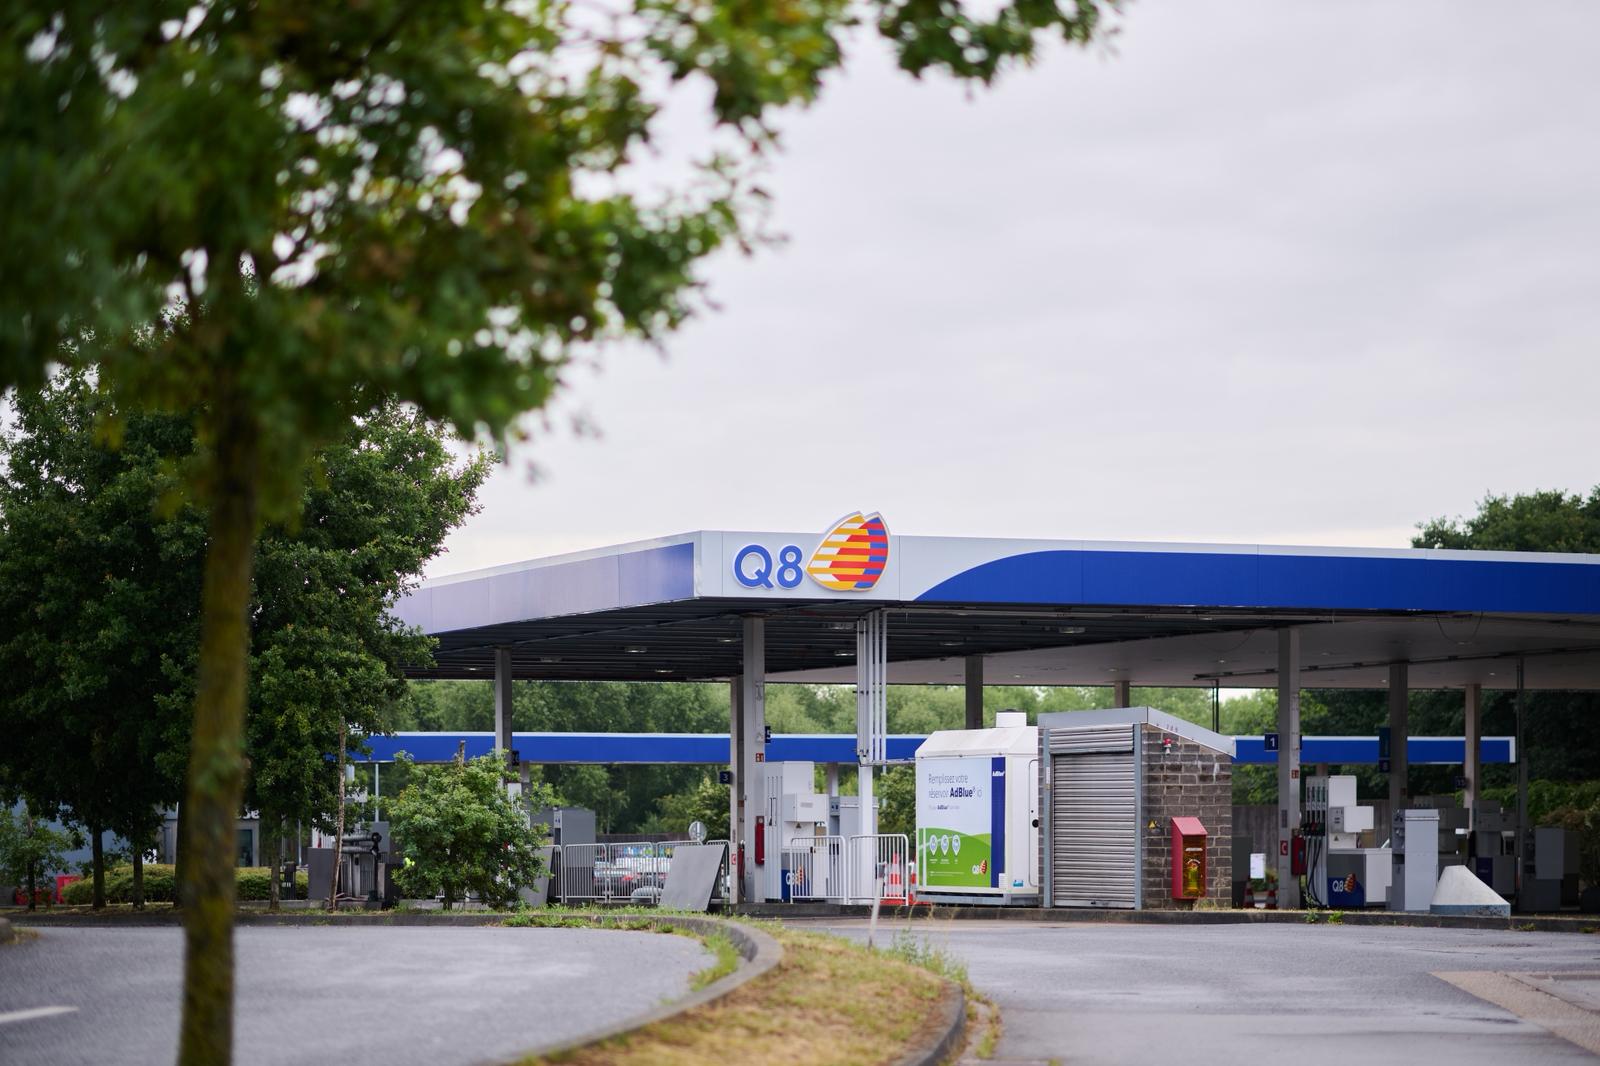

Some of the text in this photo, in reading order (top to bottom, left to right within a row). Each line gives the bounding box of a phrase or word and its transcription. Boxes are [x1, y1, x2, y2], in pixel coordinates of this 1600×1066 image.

[734, 544, 803, 589] Q8
[1270, 737, 1275, 747] 1
[723, 774, 728, 782] 3
[1332, 880, 1344, 893] Q8
